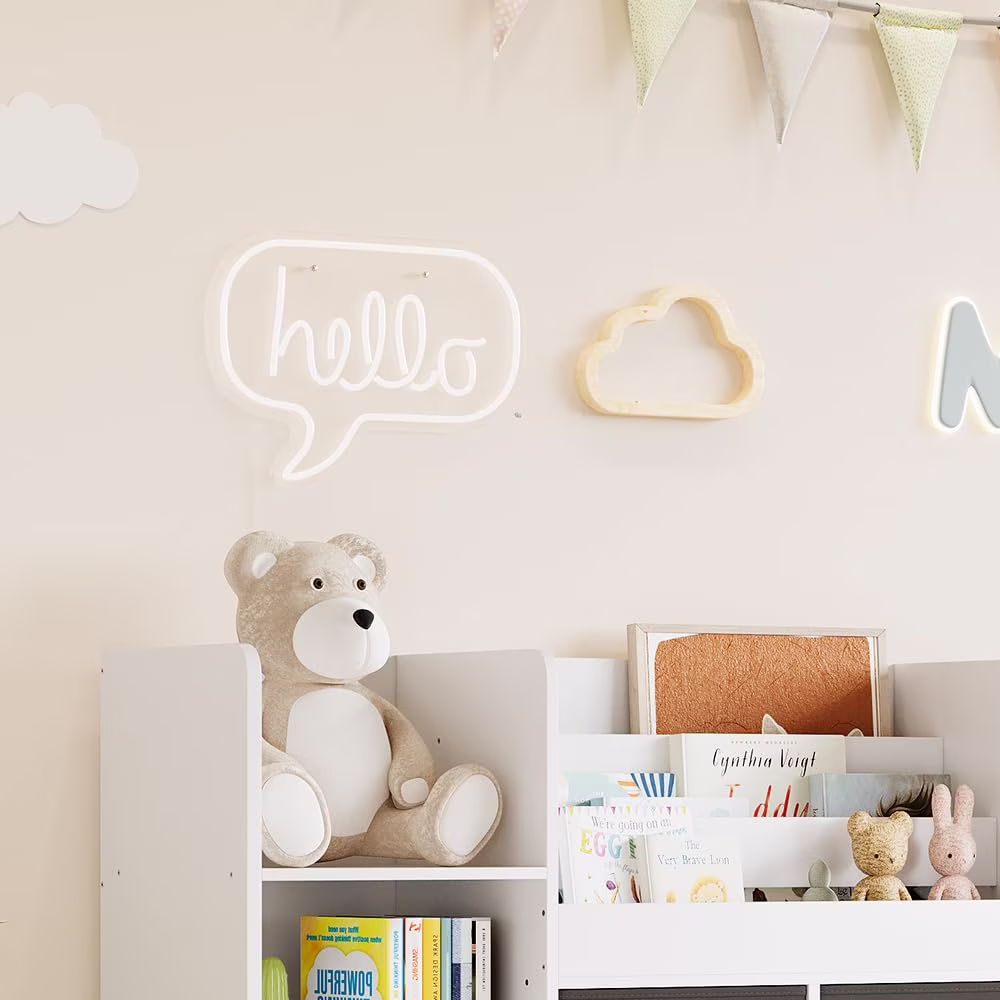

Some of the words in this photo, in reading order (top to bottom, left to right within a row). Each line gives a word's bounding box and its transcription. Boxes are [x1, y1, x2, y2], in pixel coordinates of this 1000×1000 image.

[269, 264, 487, 397] hello
[712, 747, 772, 776] Cynthia
[780, 748, 816, 777] Voigt
[591, 816, 615, 829] We're
[617, 819, 644, 833] going
[646, 818, 659, 829] on
[659, 817, 672, 828] an
[580, 828, 622, 859] EGG
[685, 840, 702, 850] The
[657, 855, 677, 866] Very
[682, 855, 706, 865] Brave
[709, 855, 730, 865] Lion
